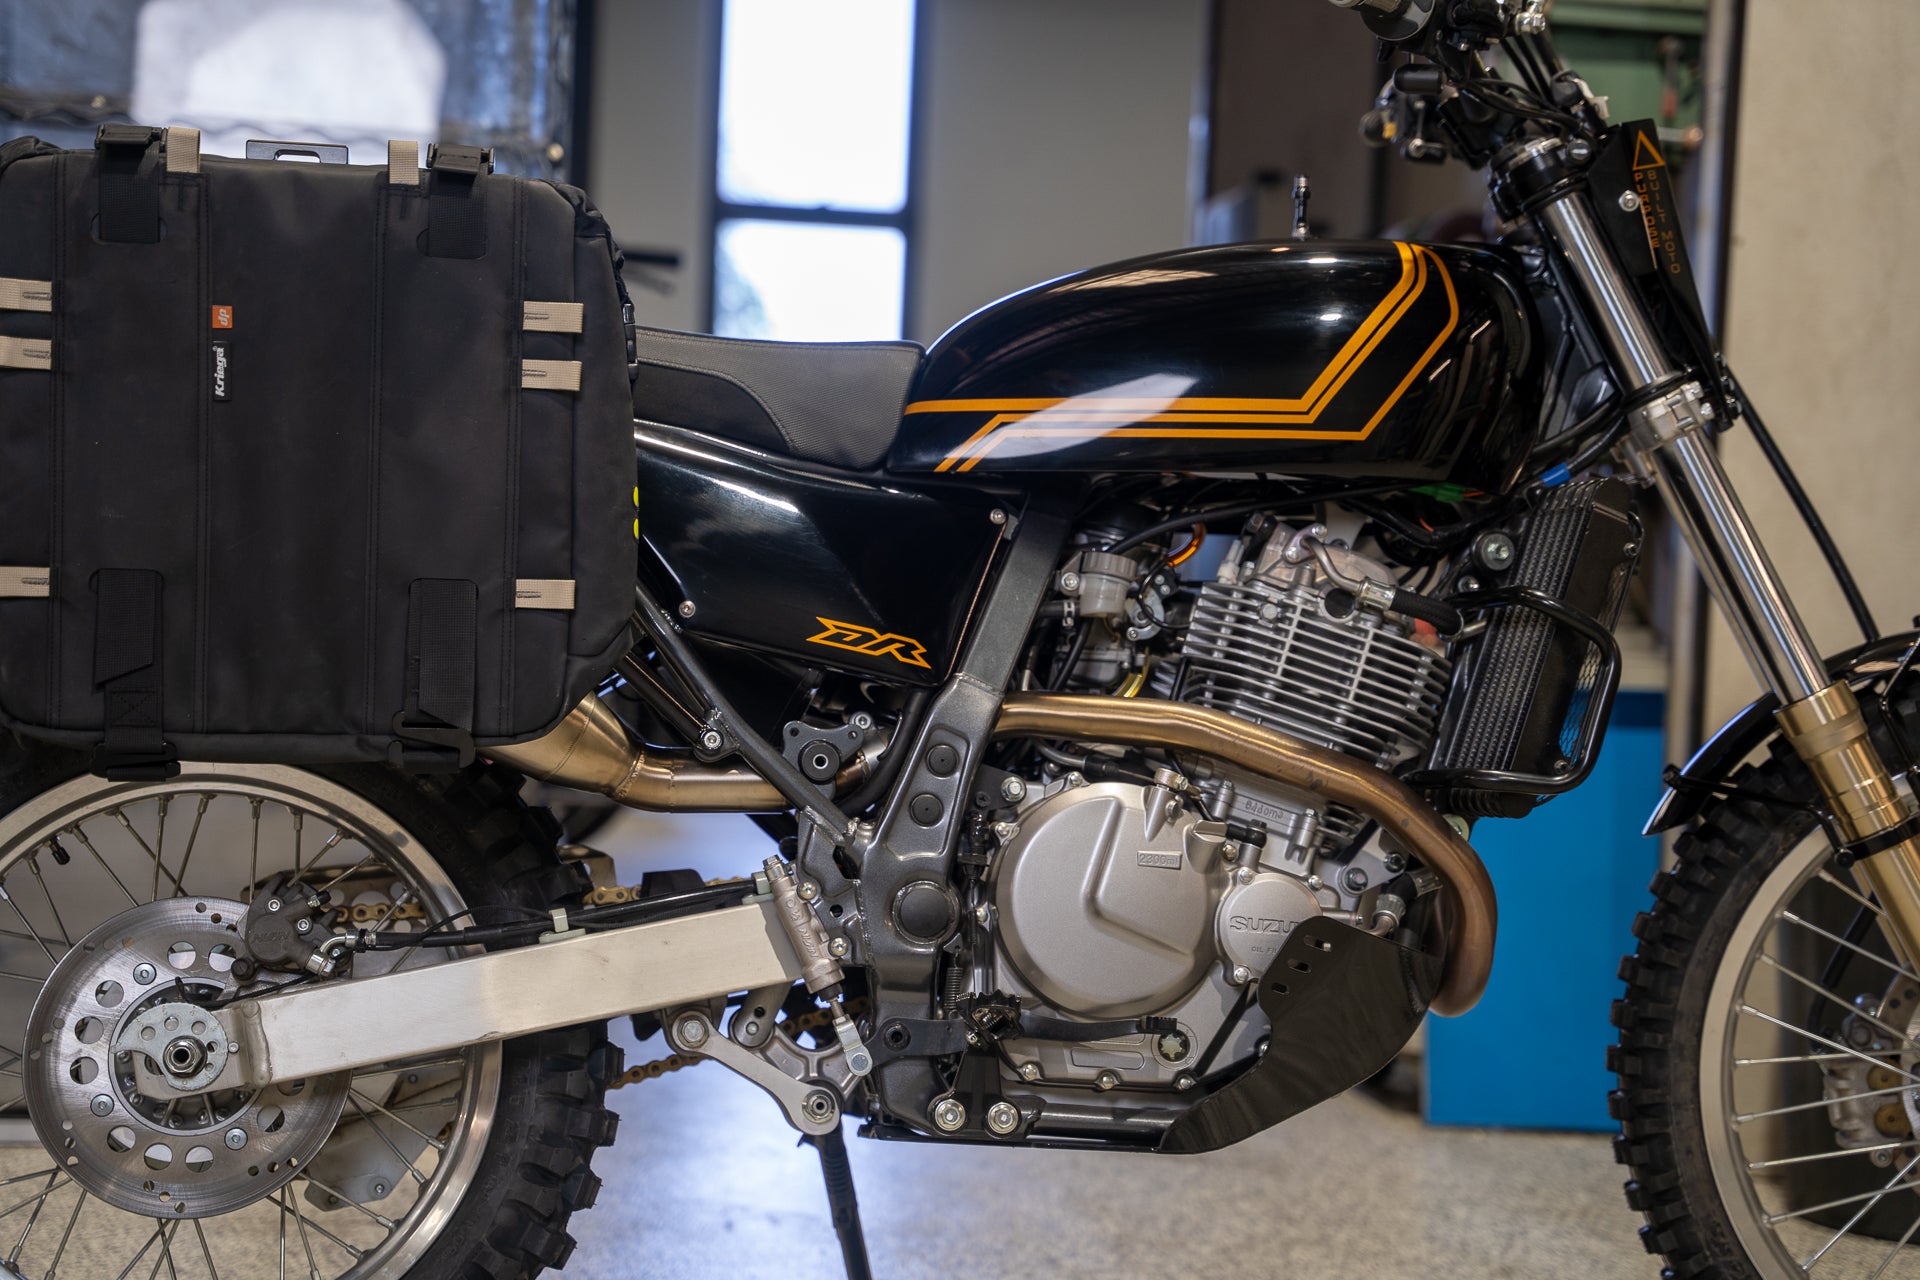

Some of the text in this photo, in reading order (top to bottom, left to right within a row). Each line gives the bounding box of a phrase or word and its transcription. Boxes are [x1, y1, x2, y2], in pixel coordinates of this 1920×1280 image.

[1634, 170, 1660, 249] PURPOSE
[1647, 169, 1681, 274] BUILT MOTO
[806, 616, 932, 669] DR
[1229, 915, 1299, 934] SUZU
[1251, 945, 1264, 953] OIL
